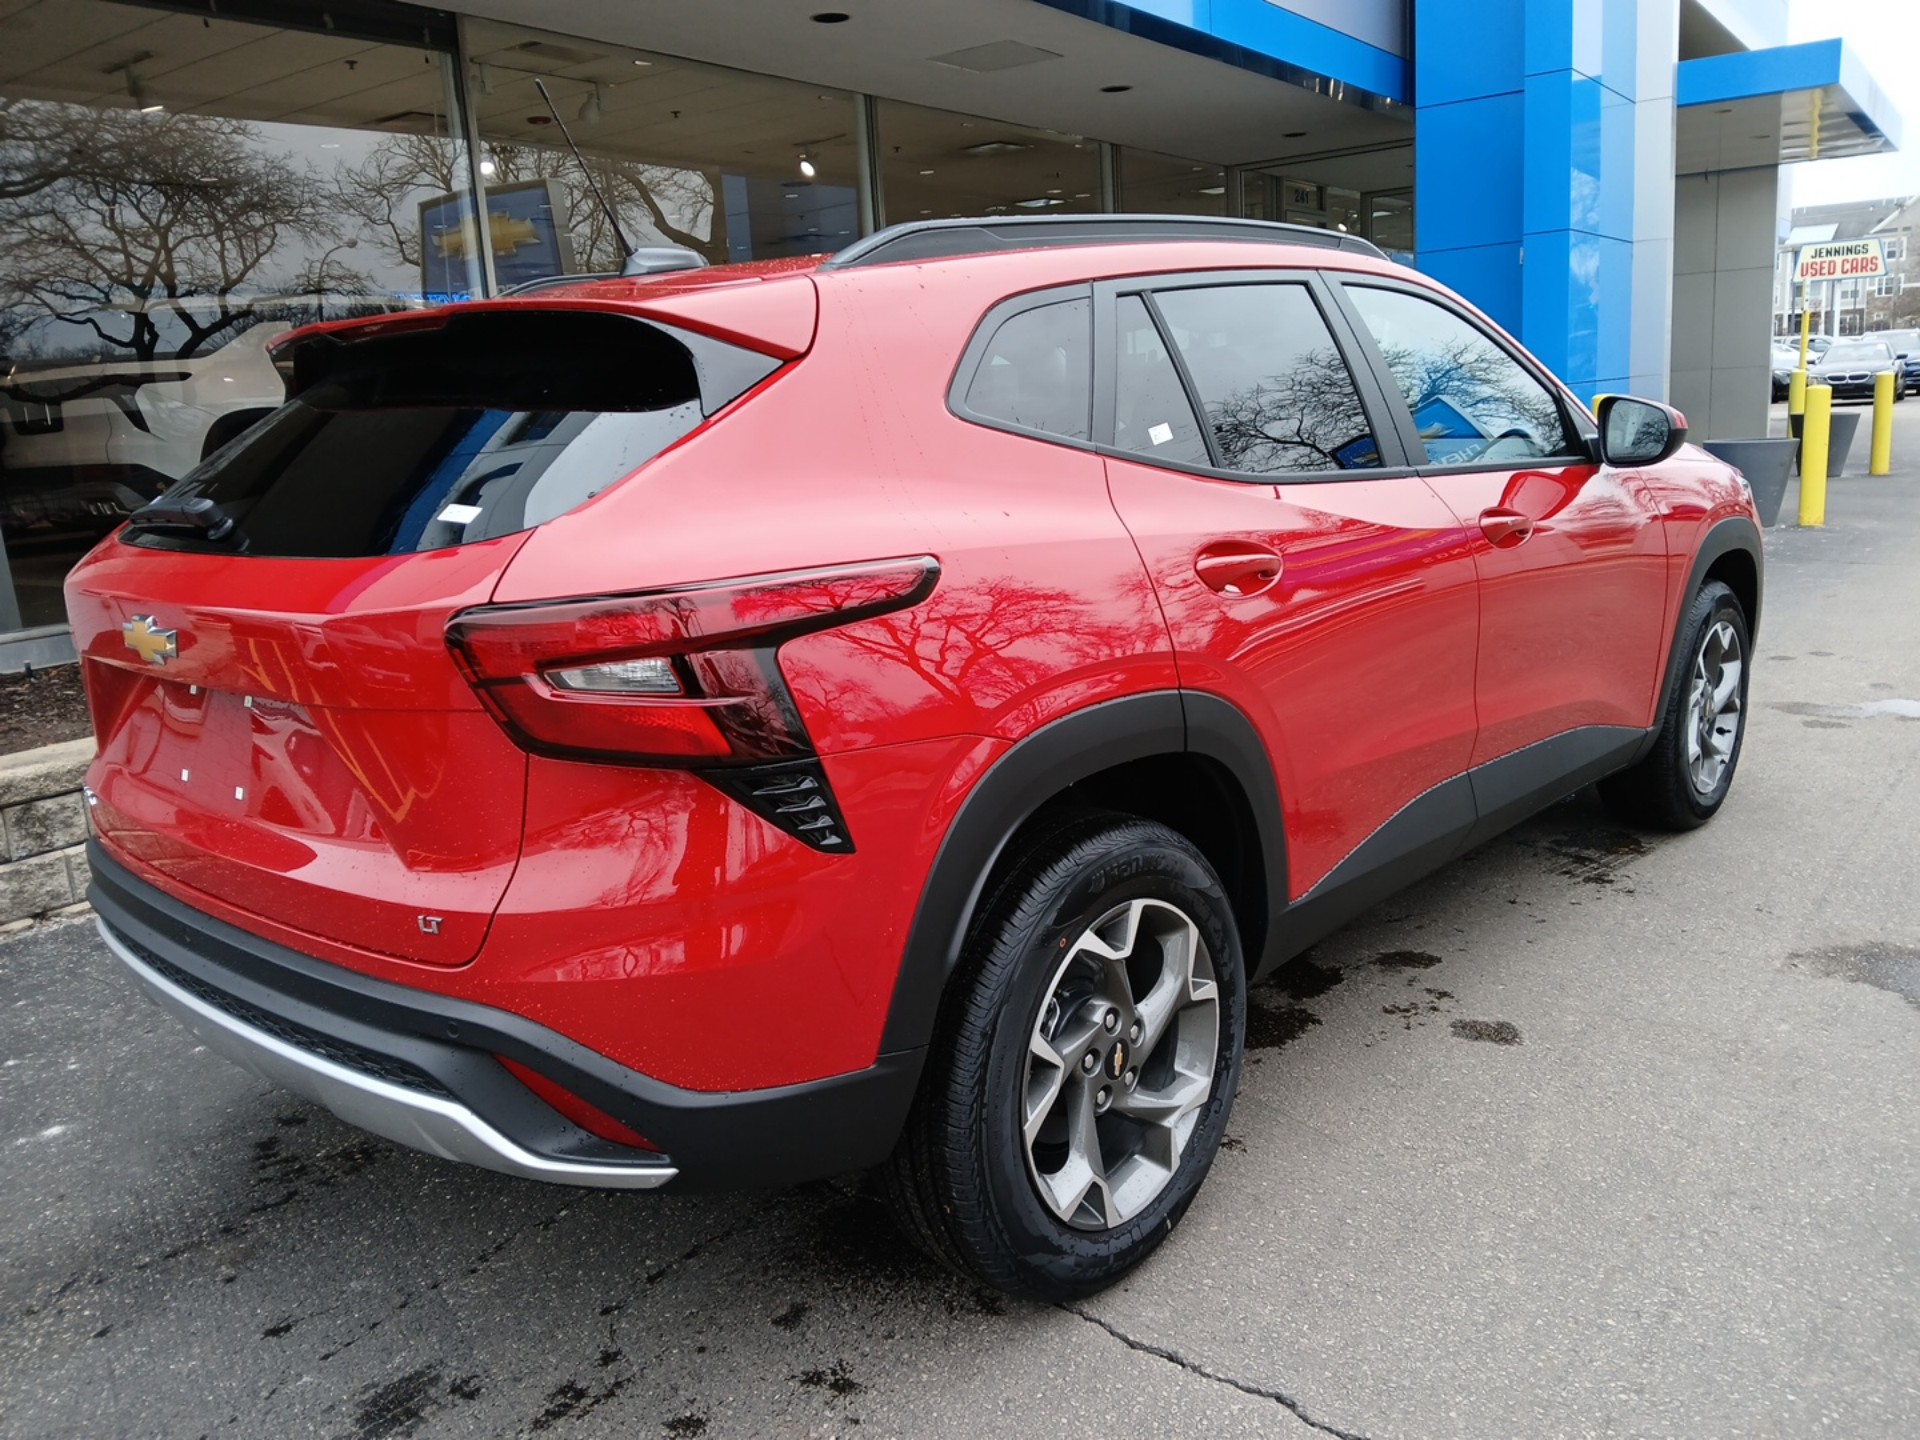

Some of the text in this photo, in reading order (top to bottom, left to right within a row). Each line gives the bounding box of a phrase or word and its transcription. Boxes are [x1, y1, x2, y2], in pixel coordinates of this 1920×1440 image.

[1295, 188, 1309, 205] 241
[1811, 244, 1869, 259] JENNINGS
[1800, 256, 1879, 277] USED CARS
[417, 915, 443, 935] LT
